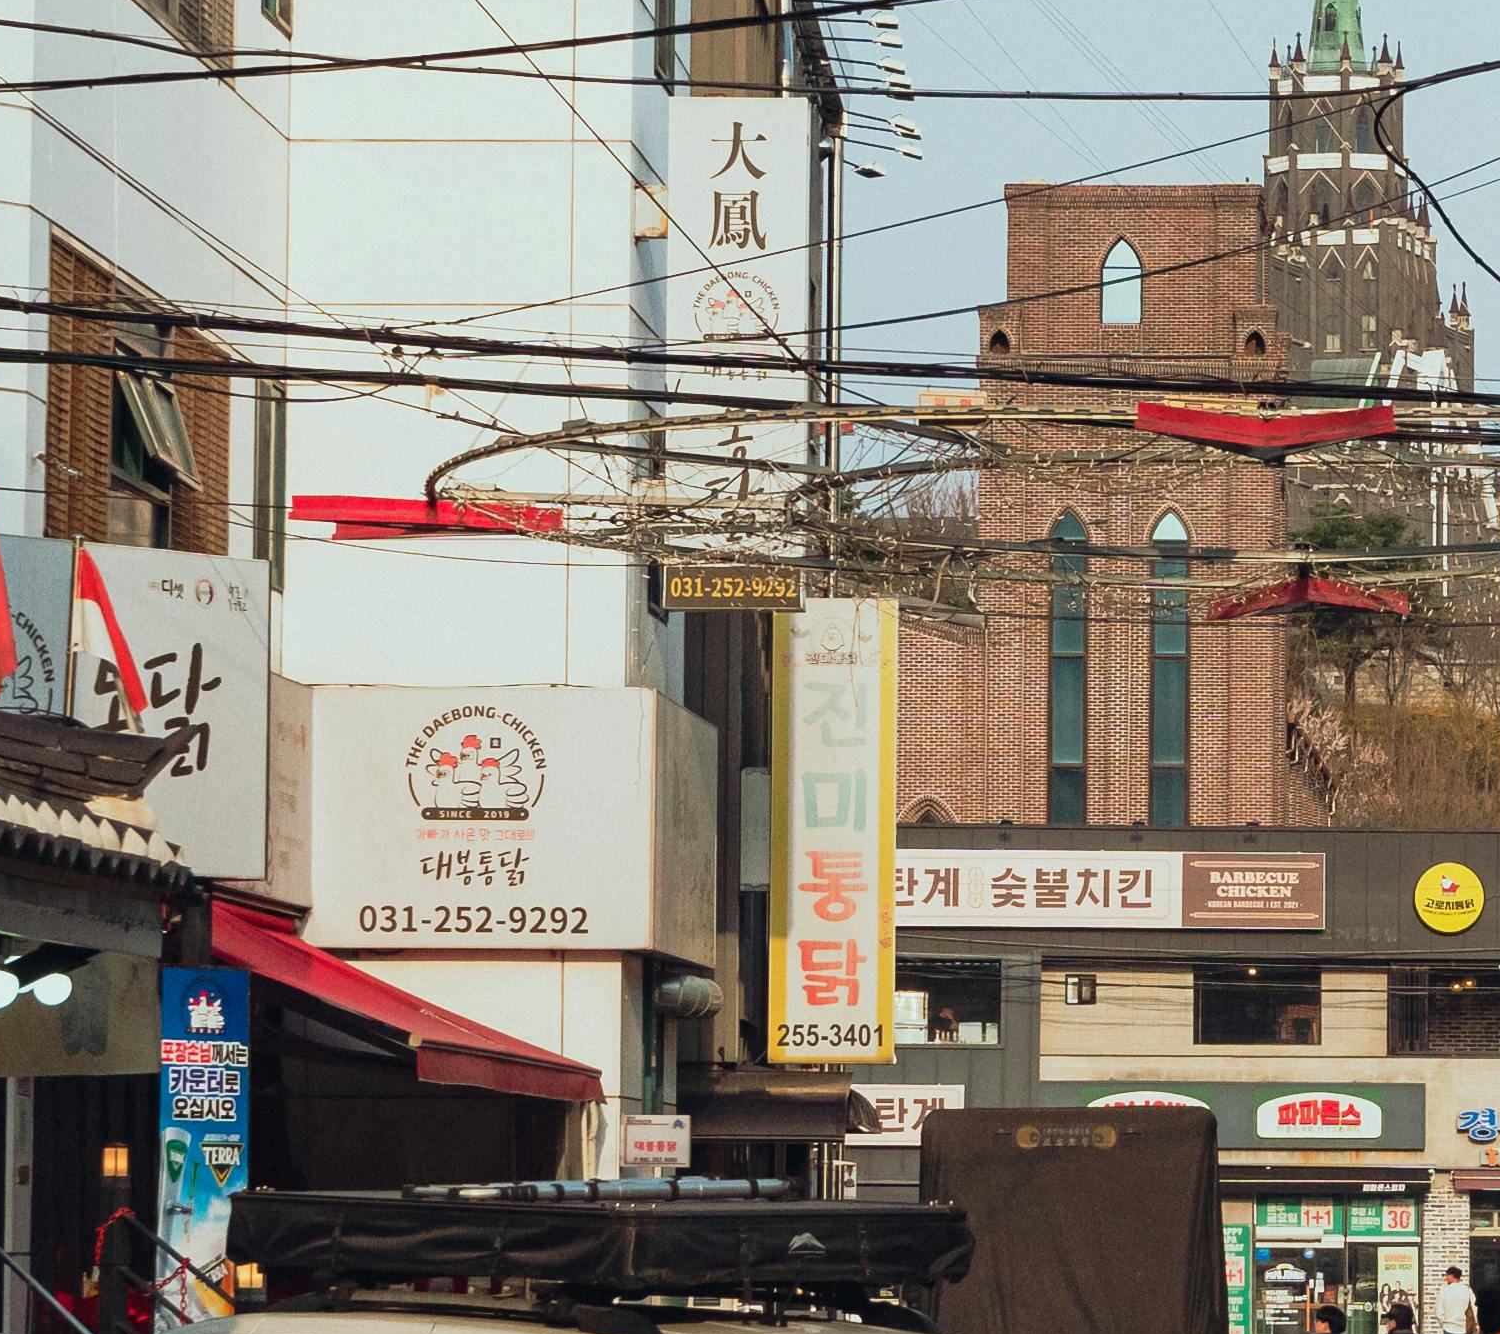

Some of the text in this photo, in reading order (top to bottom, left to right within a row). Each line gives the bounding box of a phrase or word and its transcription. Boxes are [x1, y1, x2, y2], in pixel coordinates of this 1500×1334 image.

[405, 737, 428, 769] THE
[438, 809, 511, 819] SINCE 2019
[419, 847, 531, 888] 대봉통닭
[1209, 870, 1300, 885] BARBECUE
[990, 867, 1153, 909] 숯불치킨
[1216, 885, 1293, 898] CHICKEN
[358, 904, 590, 935] 031-252-9292
[776, 1022, 886, 1048] 255-3401
[160, 1042, 248, 1065] 포장손님께서는
[170, 1069, 240, 1095] 카운터로
[172, 1097, 238, 1121] 오십시오
[1278, 1099, 1362, 1126] 파파존스
[201, 1144, 243, 1167] TERRA
